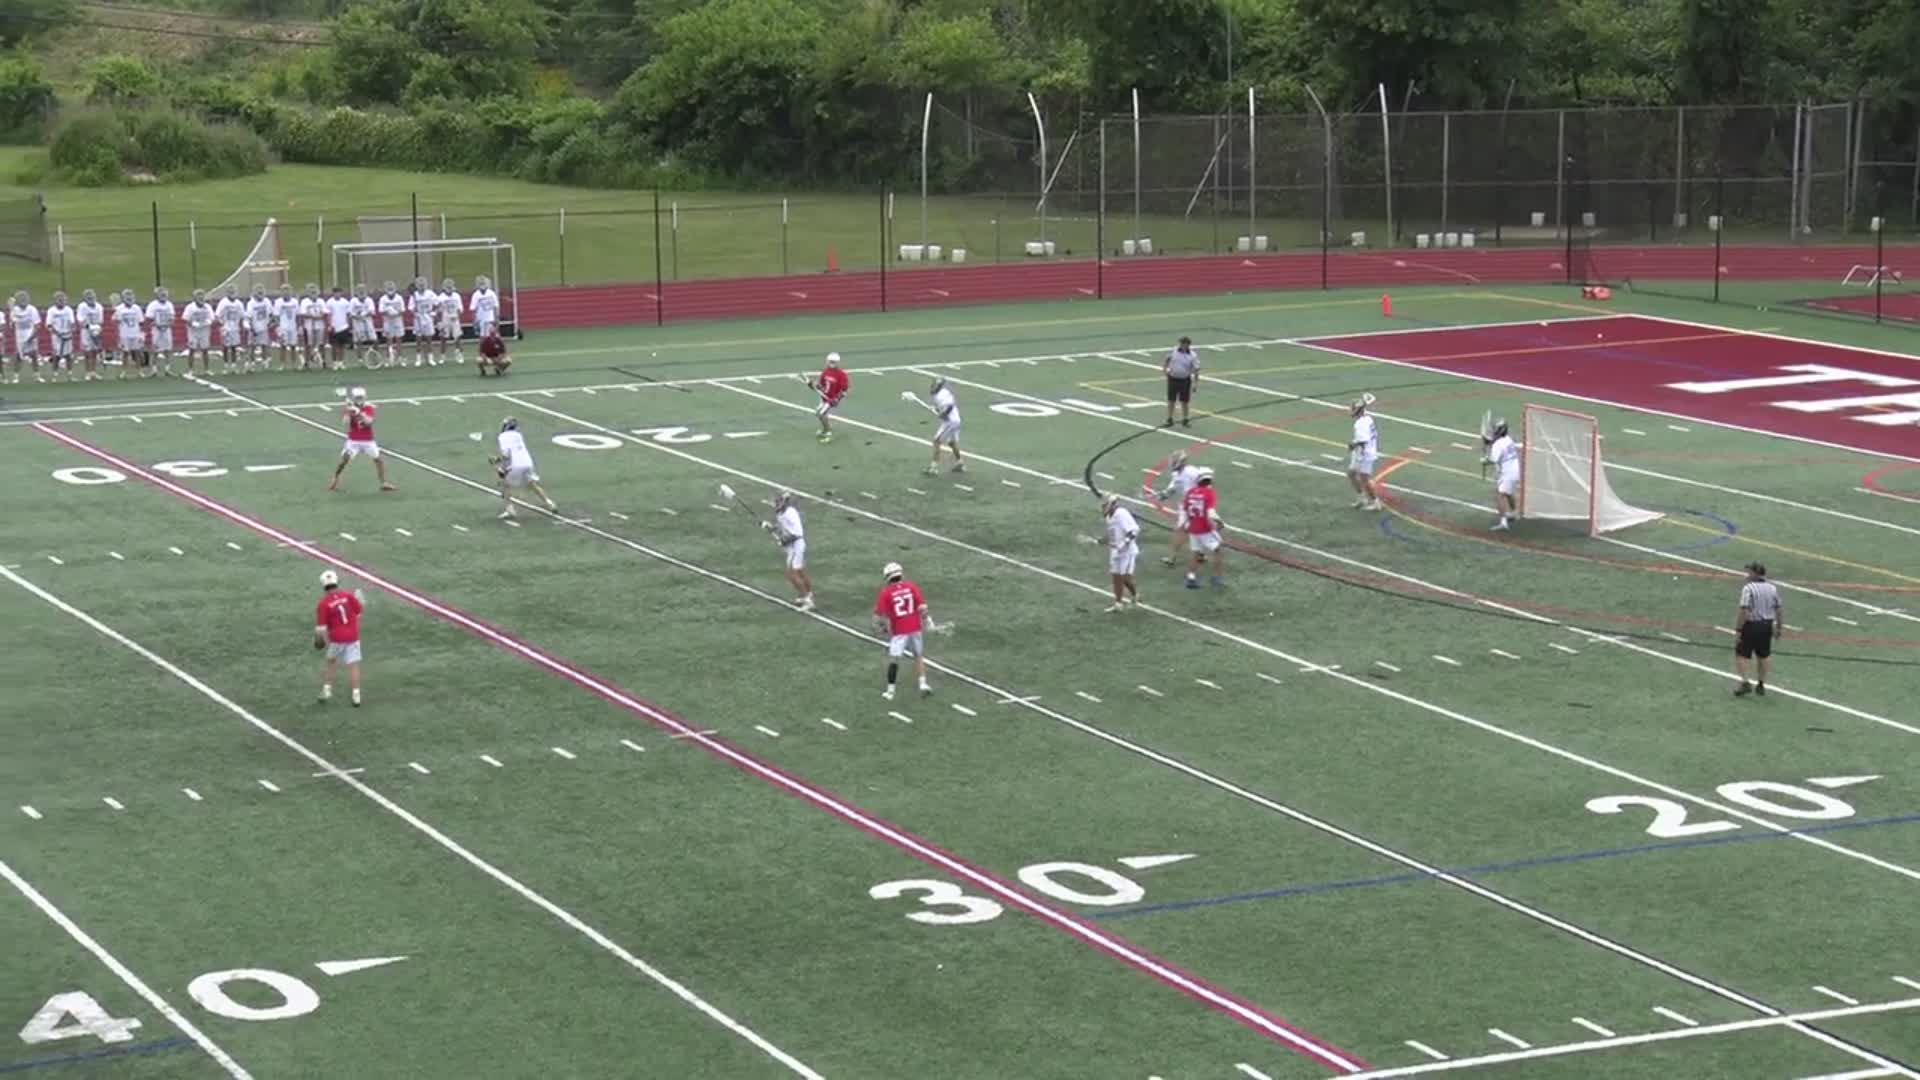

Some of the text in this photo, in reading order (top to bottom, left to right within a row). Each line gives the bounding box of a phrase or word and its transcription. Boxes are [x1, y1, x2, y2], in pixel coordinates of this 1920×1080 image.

[551, 426, 713, 450] 20
[51, 460, 229, 485] 30
[893, 593, 914, 617] 27
[1585, 780, 1856, 838] 20
[868, 861, 1145, 925] 30
[18, 968, 321, 1044] 40
